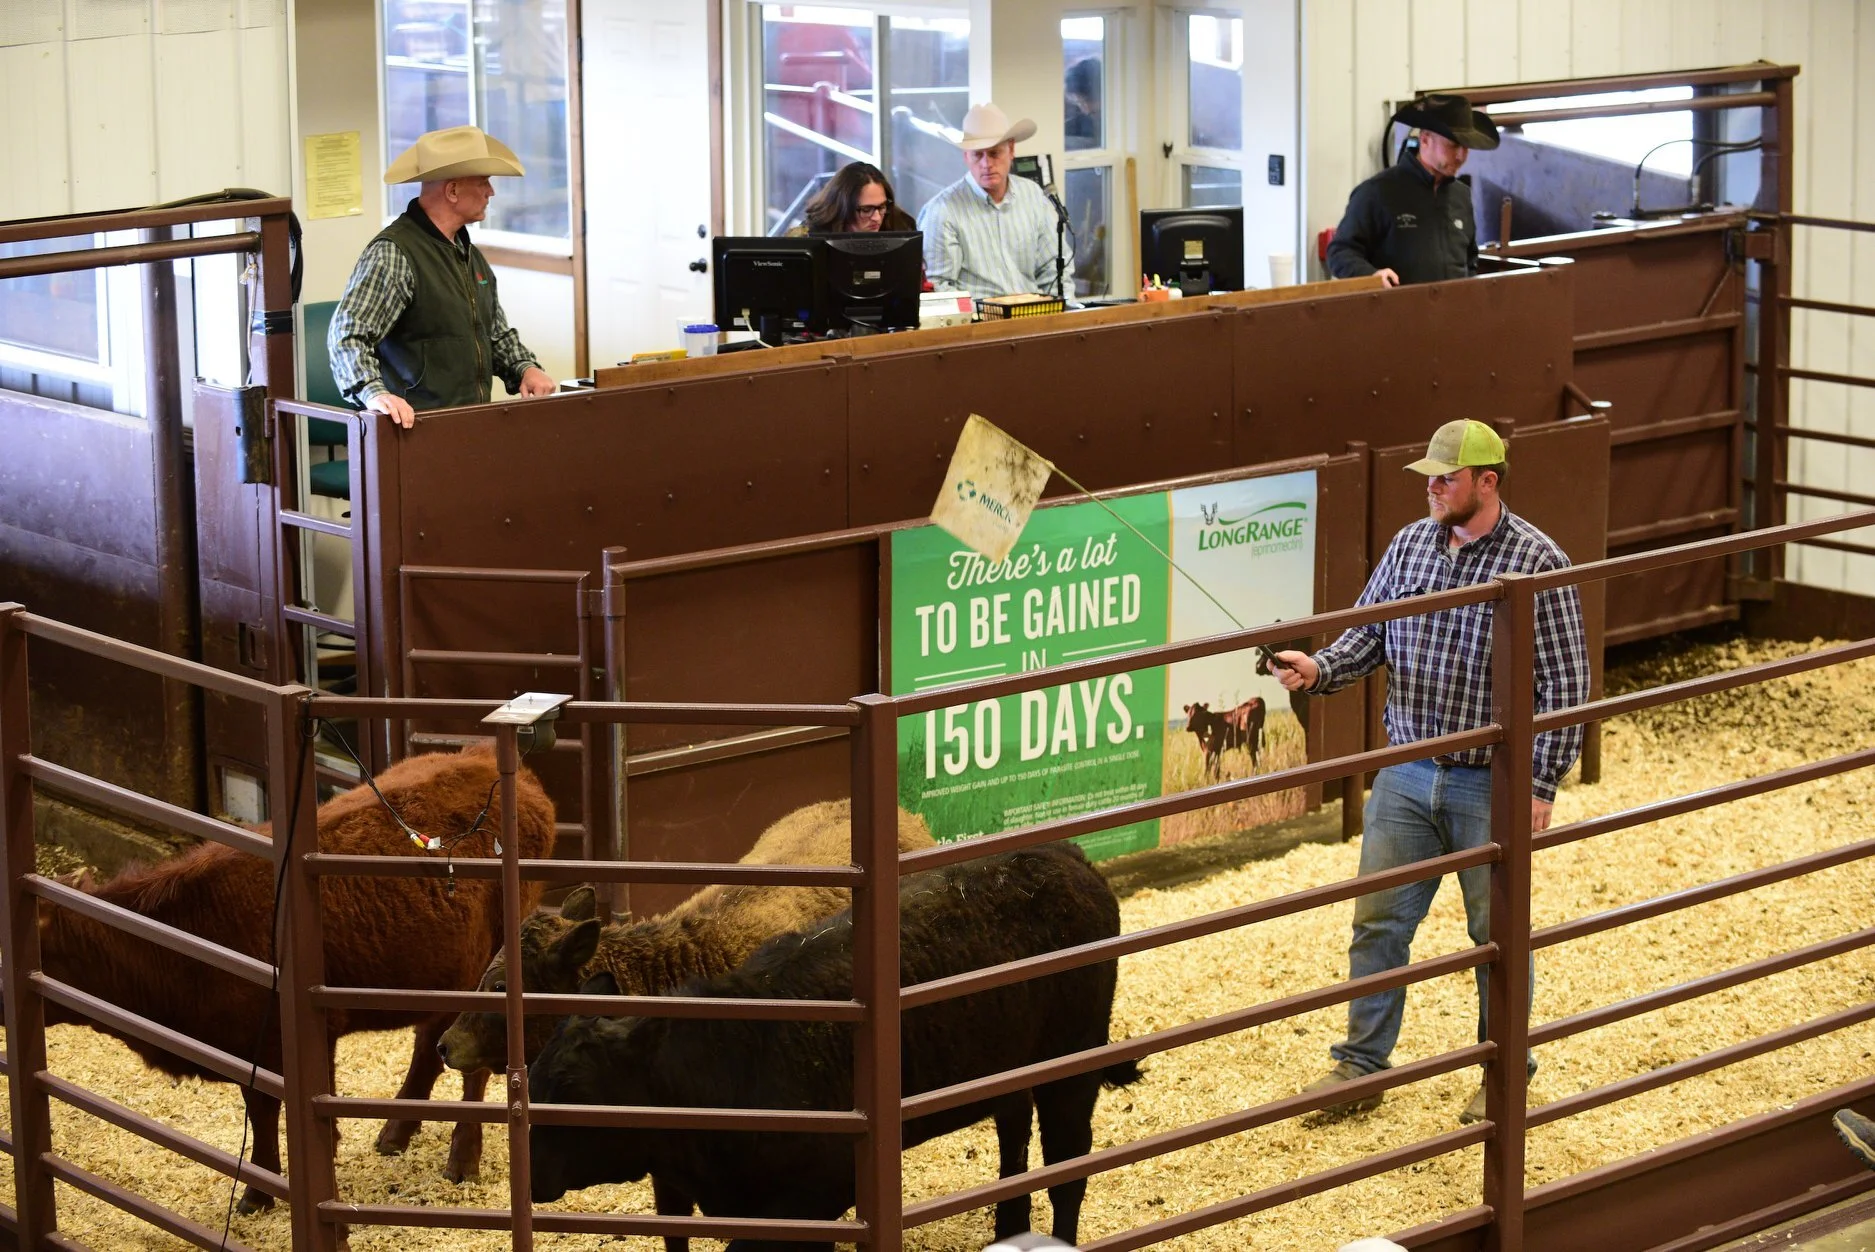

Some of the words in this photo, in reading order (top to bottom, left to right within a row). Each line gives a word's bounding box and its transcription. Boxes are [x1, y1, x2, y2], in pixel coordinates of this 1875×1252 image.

[979, 493, 1011, 523] MERCK
[947, 544, 1052, 590] There's
[1056, 547, 1076, 573] a
[1081, 533, 1118, 570] lot
[915, 601, 957, 656] TO
[970, 592, 1011, 648] BE
[1023, 573, 1141, 640] GAINED
[1022, 648, 1046, 672] IN
[926, 698, 1001, 779] 150
[1021, 673, 1144, 761] DAYS.
[921, 787, 950, 799] IMPROVED
[950, 783, 972, 794] WEIGHT
[972, 780, 987, 789] GAIN
[987, 777, 1000, 787] AND
[1000, 776, 1008, 784] UP
[1009, 774, 1017, 783] TO
[1027, 769, 1041, 779] DAYS
[1041, 768, 1049, 777] OF
[1109, 753, 1125, 762] SINGLE
